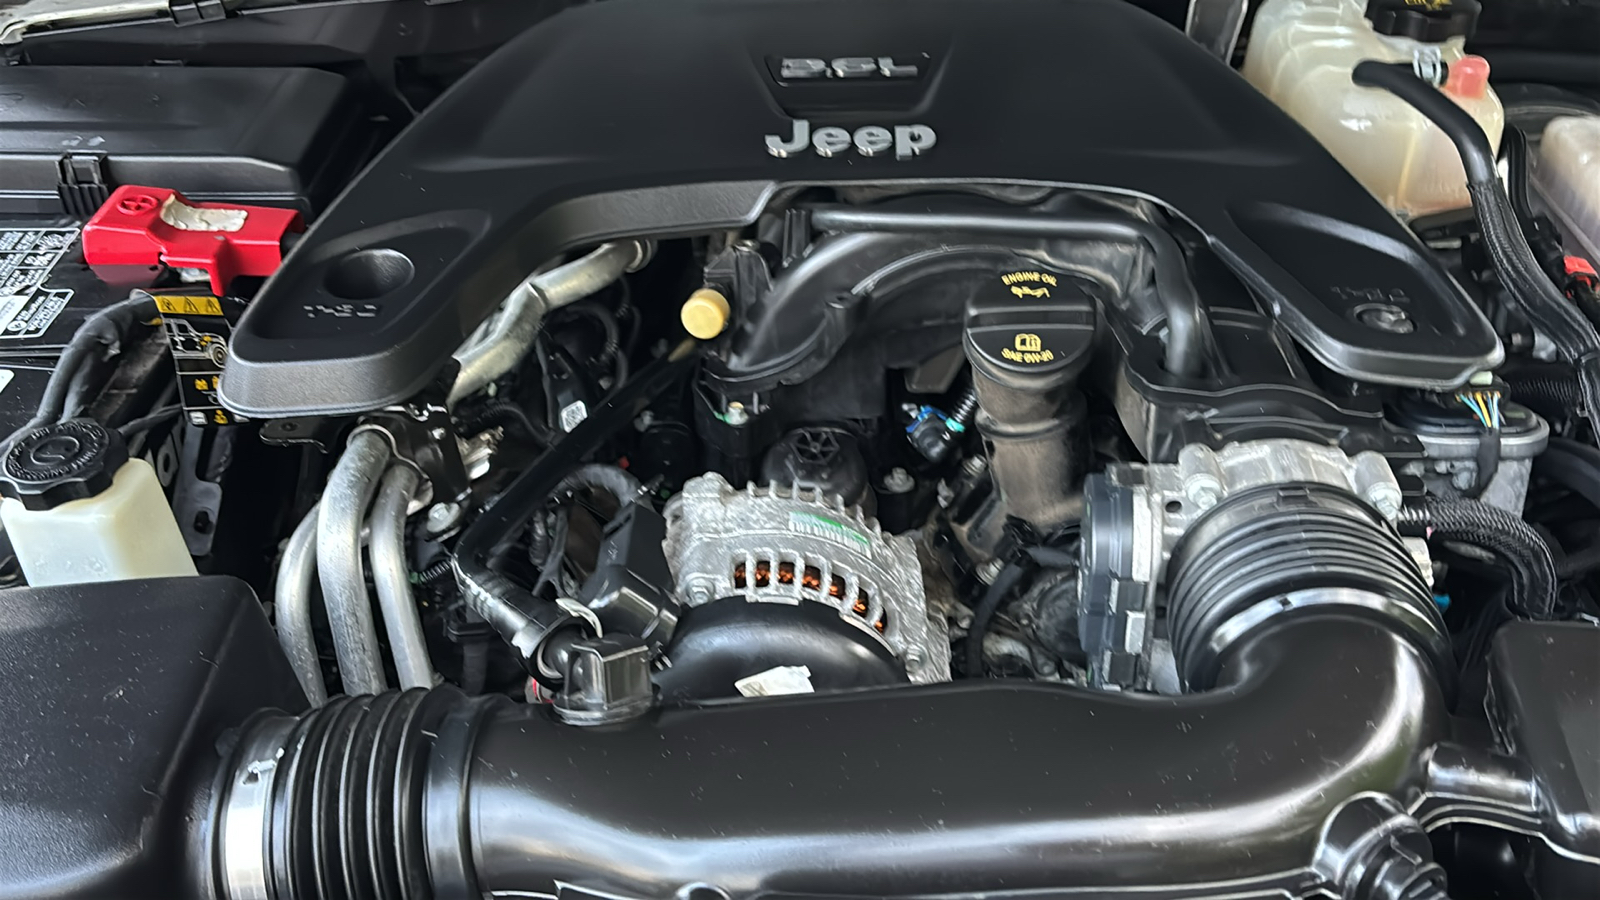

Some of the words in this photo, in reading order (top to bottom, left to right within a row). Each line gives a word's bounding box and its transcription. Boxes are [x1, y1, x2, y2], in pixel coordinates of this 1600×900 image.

[764, 119, 937, 161] Jeep
[1001, 271, 1040, 286] ENGINE
[1041, 273, 1057, 287] OIL
[1001, 347, 1023, 363] SAE
